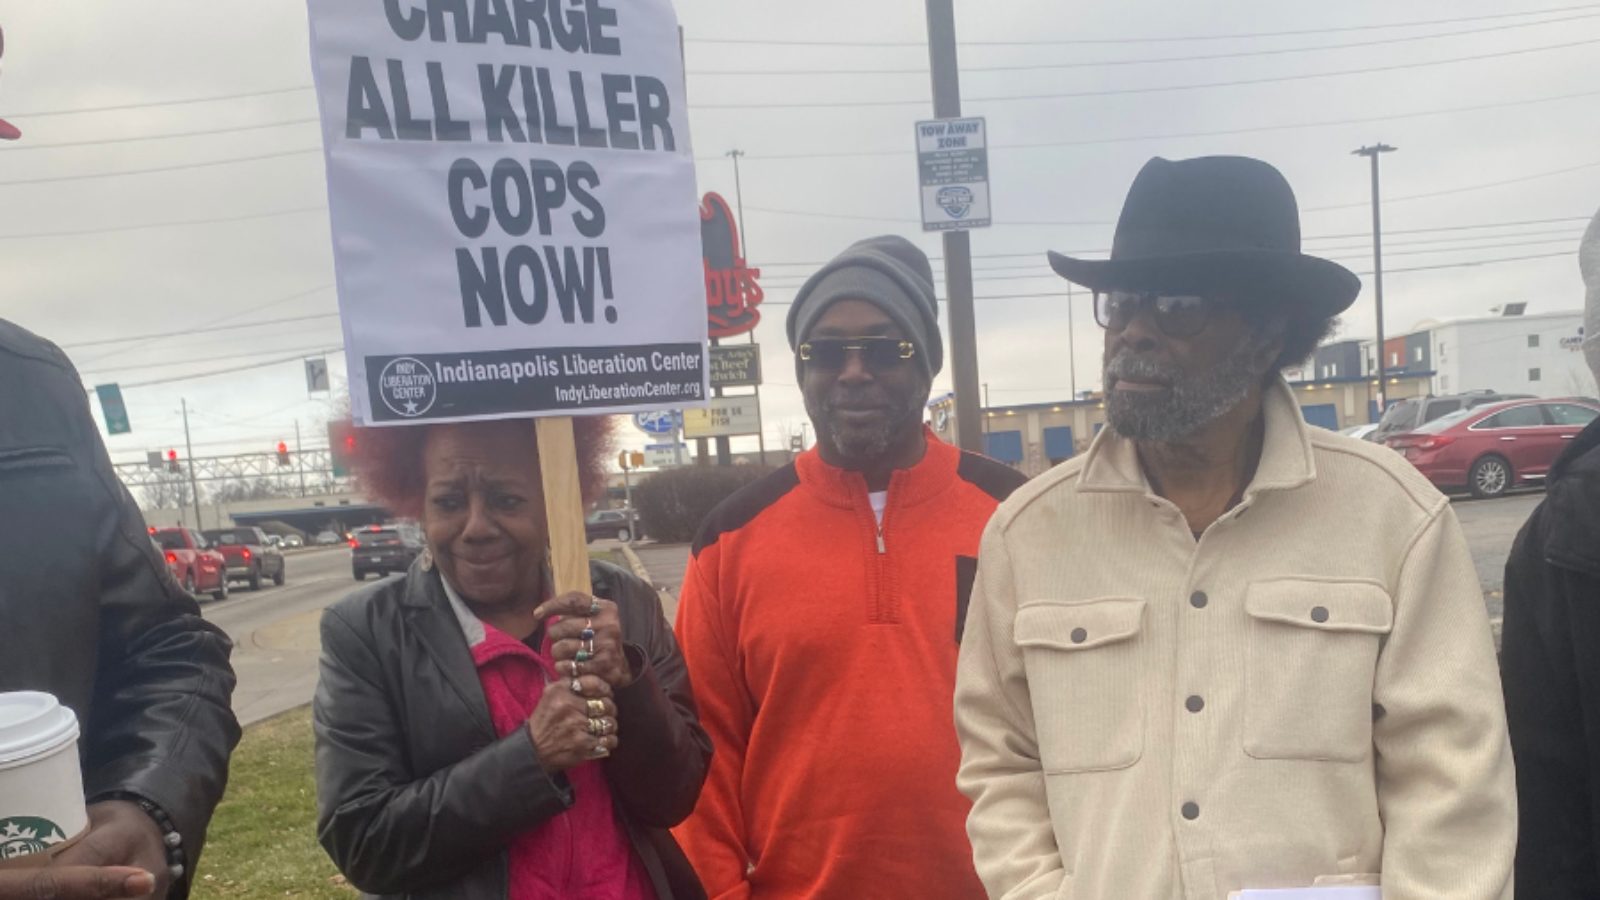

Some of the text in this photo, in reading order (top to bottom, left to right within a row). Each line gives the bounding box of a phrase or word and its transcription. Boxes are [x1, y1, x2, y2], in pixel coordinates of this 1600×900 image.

[383, 0, 621, 55] CHARGE
[345, 55, 675, 151] ALL KILLER
[921, 122, 979, 137] TOW AWAY
[937, 137, 967, 149] ZONE
[447, 157, 606, 239] COPS
[455, 245, 618, 327] NOW!
[703, 257, 764, 317] by's
[383, 374, 432, 388] LIBERATION
[396, 362, 415, 375] INDY
[435, 355, 559, 384] Indianapolis
[562, 353, 648, 376] Liberation
[651, 351, 700, 371] Center
[392, 386, 426, 400] CENTER
[555, 382, 700, 404] IndyLiberationCenter.org
